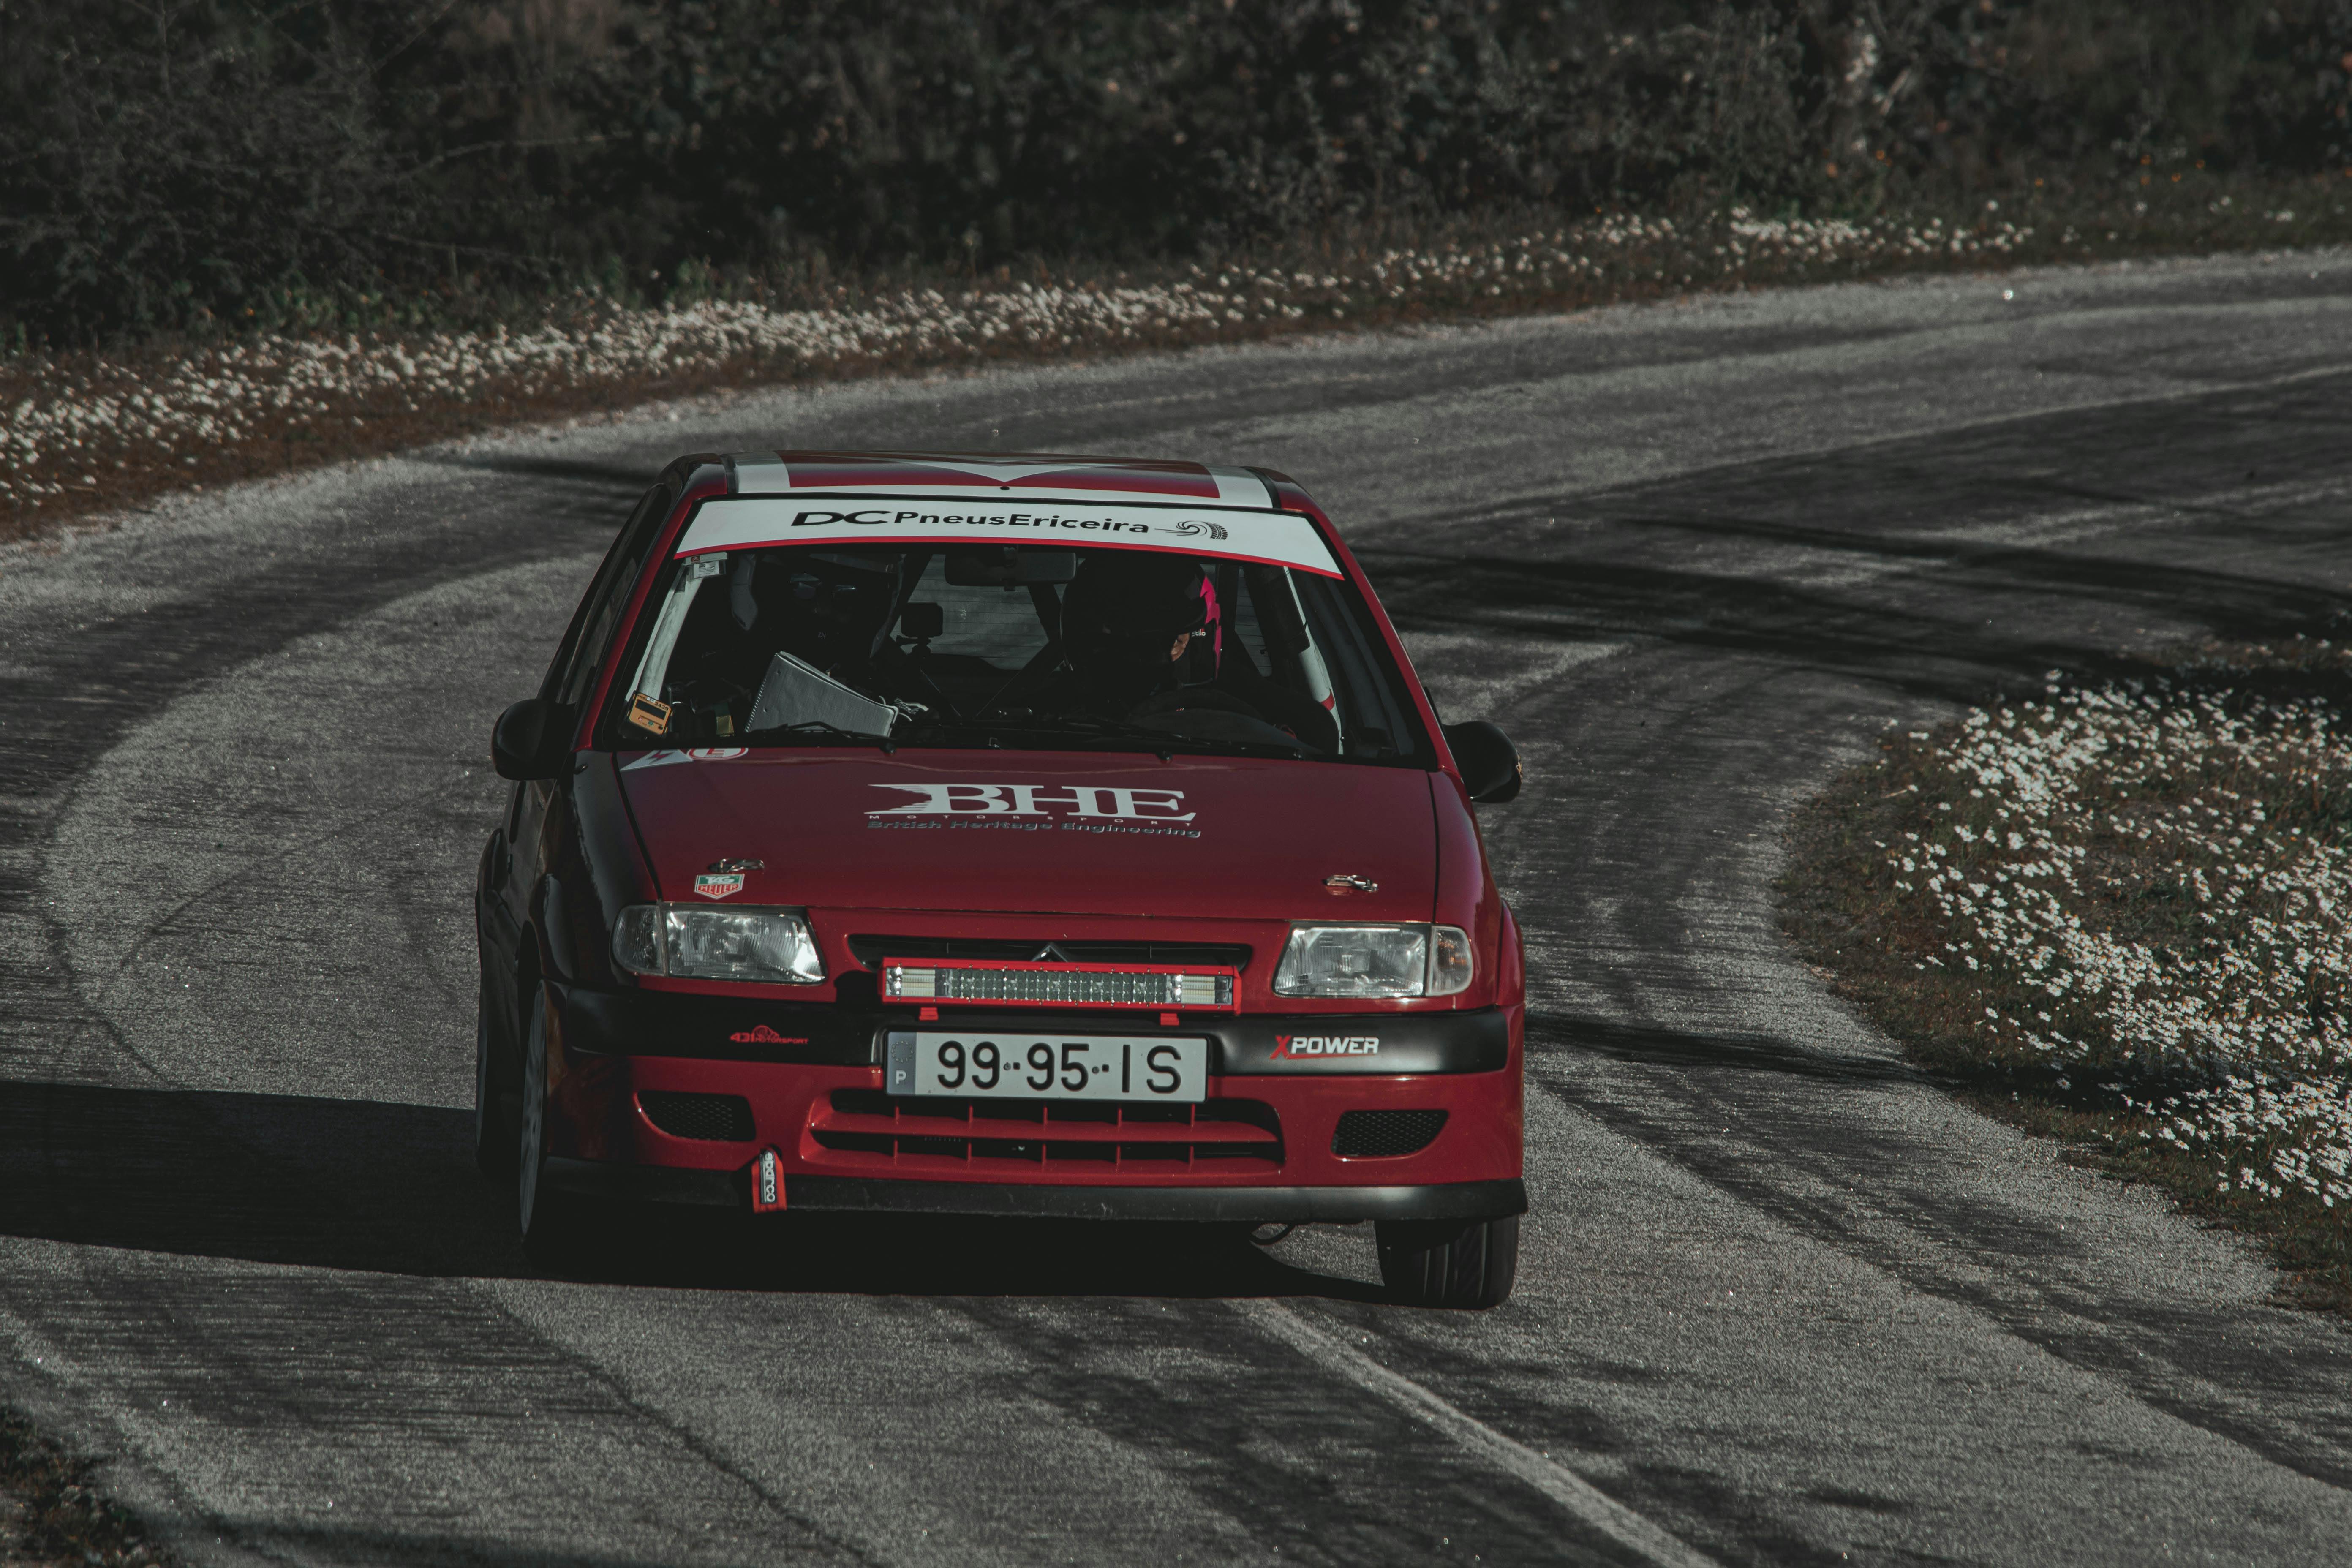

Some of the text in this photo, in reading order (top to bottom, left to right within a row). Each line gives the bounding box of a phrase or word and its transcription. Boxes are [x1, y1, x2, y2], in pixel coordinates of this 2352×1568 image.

[654, 702, 669, 711] 3439
[864, 784, 1197, 821] BHE
[867, 821, 1201, 838] British Heritage Engineering
[705, 876, 735, 884] TAG
[700, 884, 738, 895] HEUER
[1270, 1035, 1379, 1059] XPOWER
[895, 1070, 907, 1085] P
